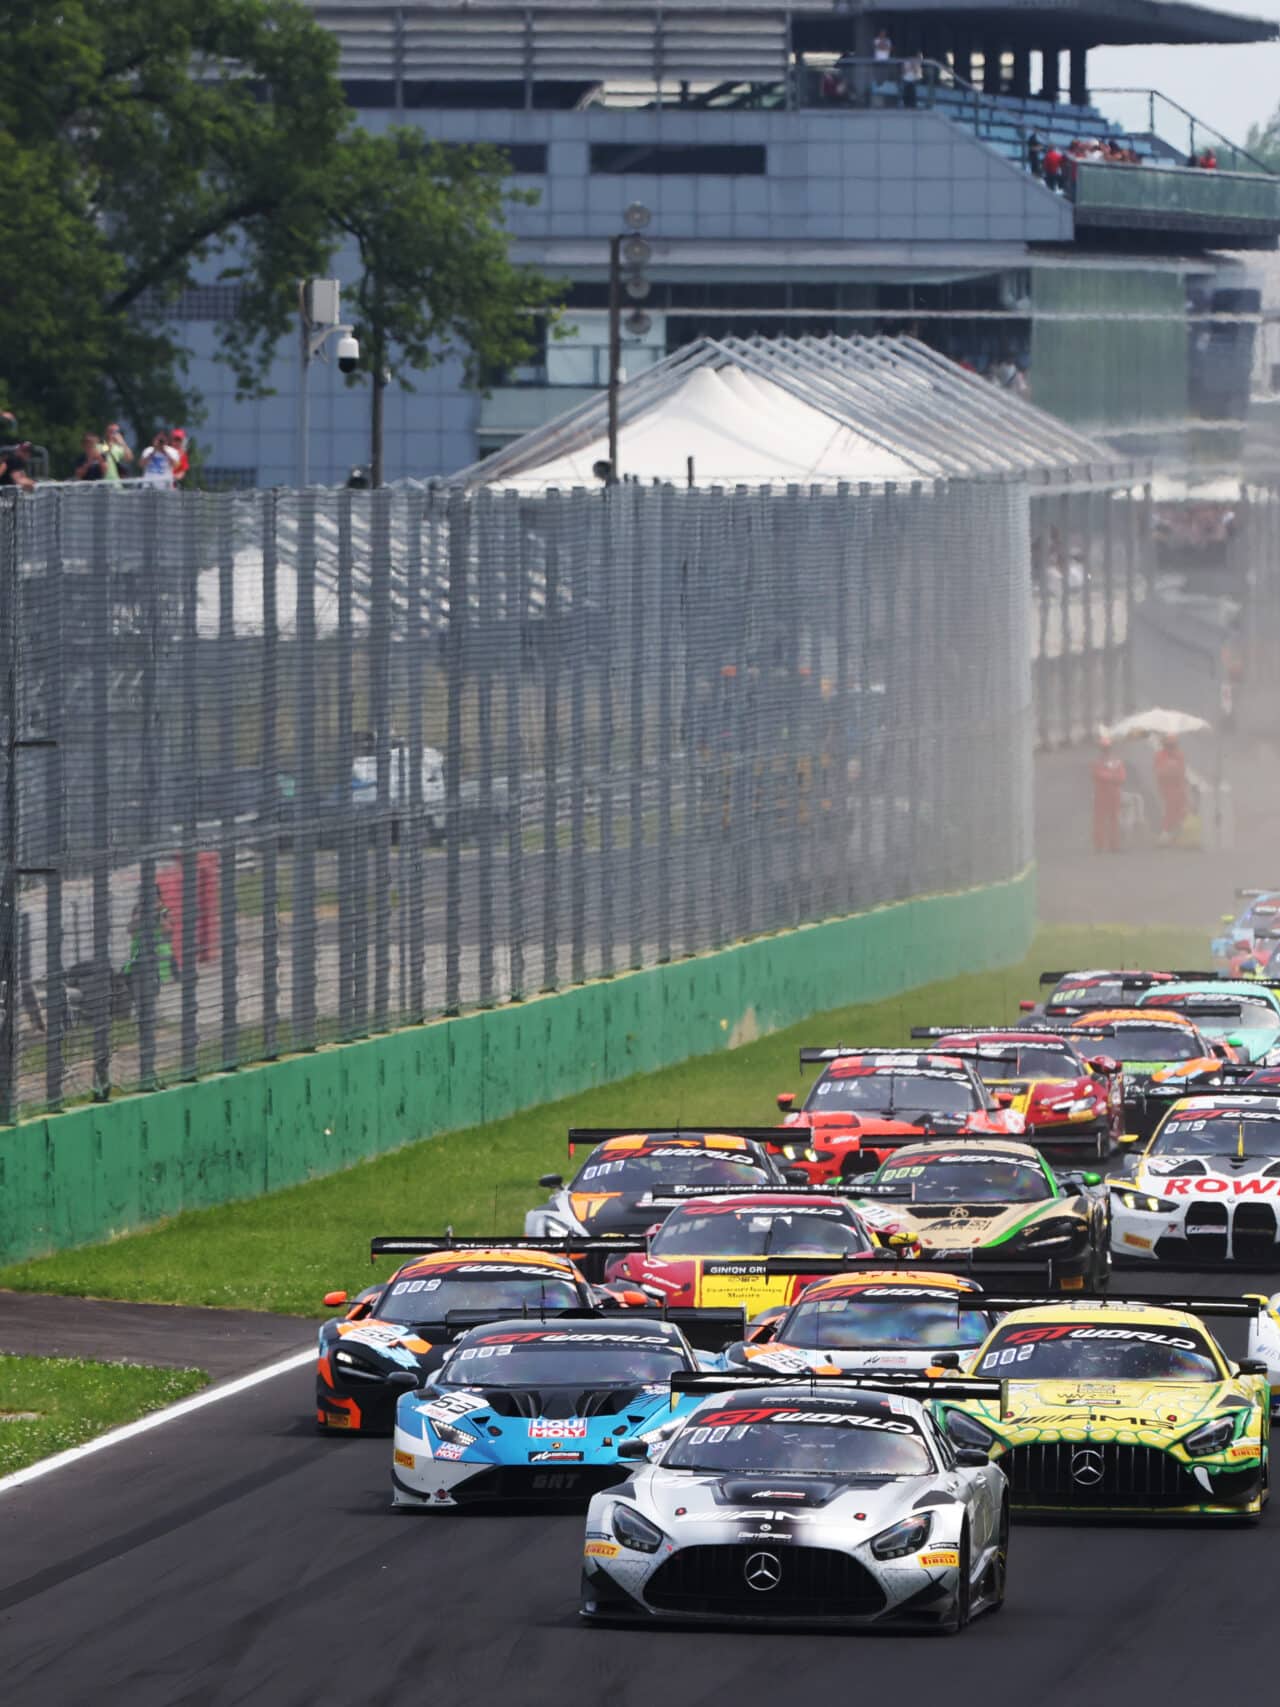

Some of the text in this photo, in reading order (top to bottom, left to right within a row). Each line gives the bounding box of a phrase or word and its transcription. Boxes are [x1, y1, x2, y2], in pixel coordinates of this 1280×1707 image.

[457, 1265, 574, 1281] WORLD
[710, 1265, 747, 1274] GINION
[863, 1287, 960, 1300] WORL
[475, 1332, 669, 1344] GT WORLD
[1004, 1325, 1197, 1350] GT WORLD
[460, 1345, 514, 1361] 003
[982, 1343, 1035, 1370] 002
[531, 1419, 585, 1429] LIQUI
[701, 1407, 914, 1435] GT WORLD
[1060, 1413, 1175, 1430] AMG
[531, 1427, 585, 1438] MOLY
